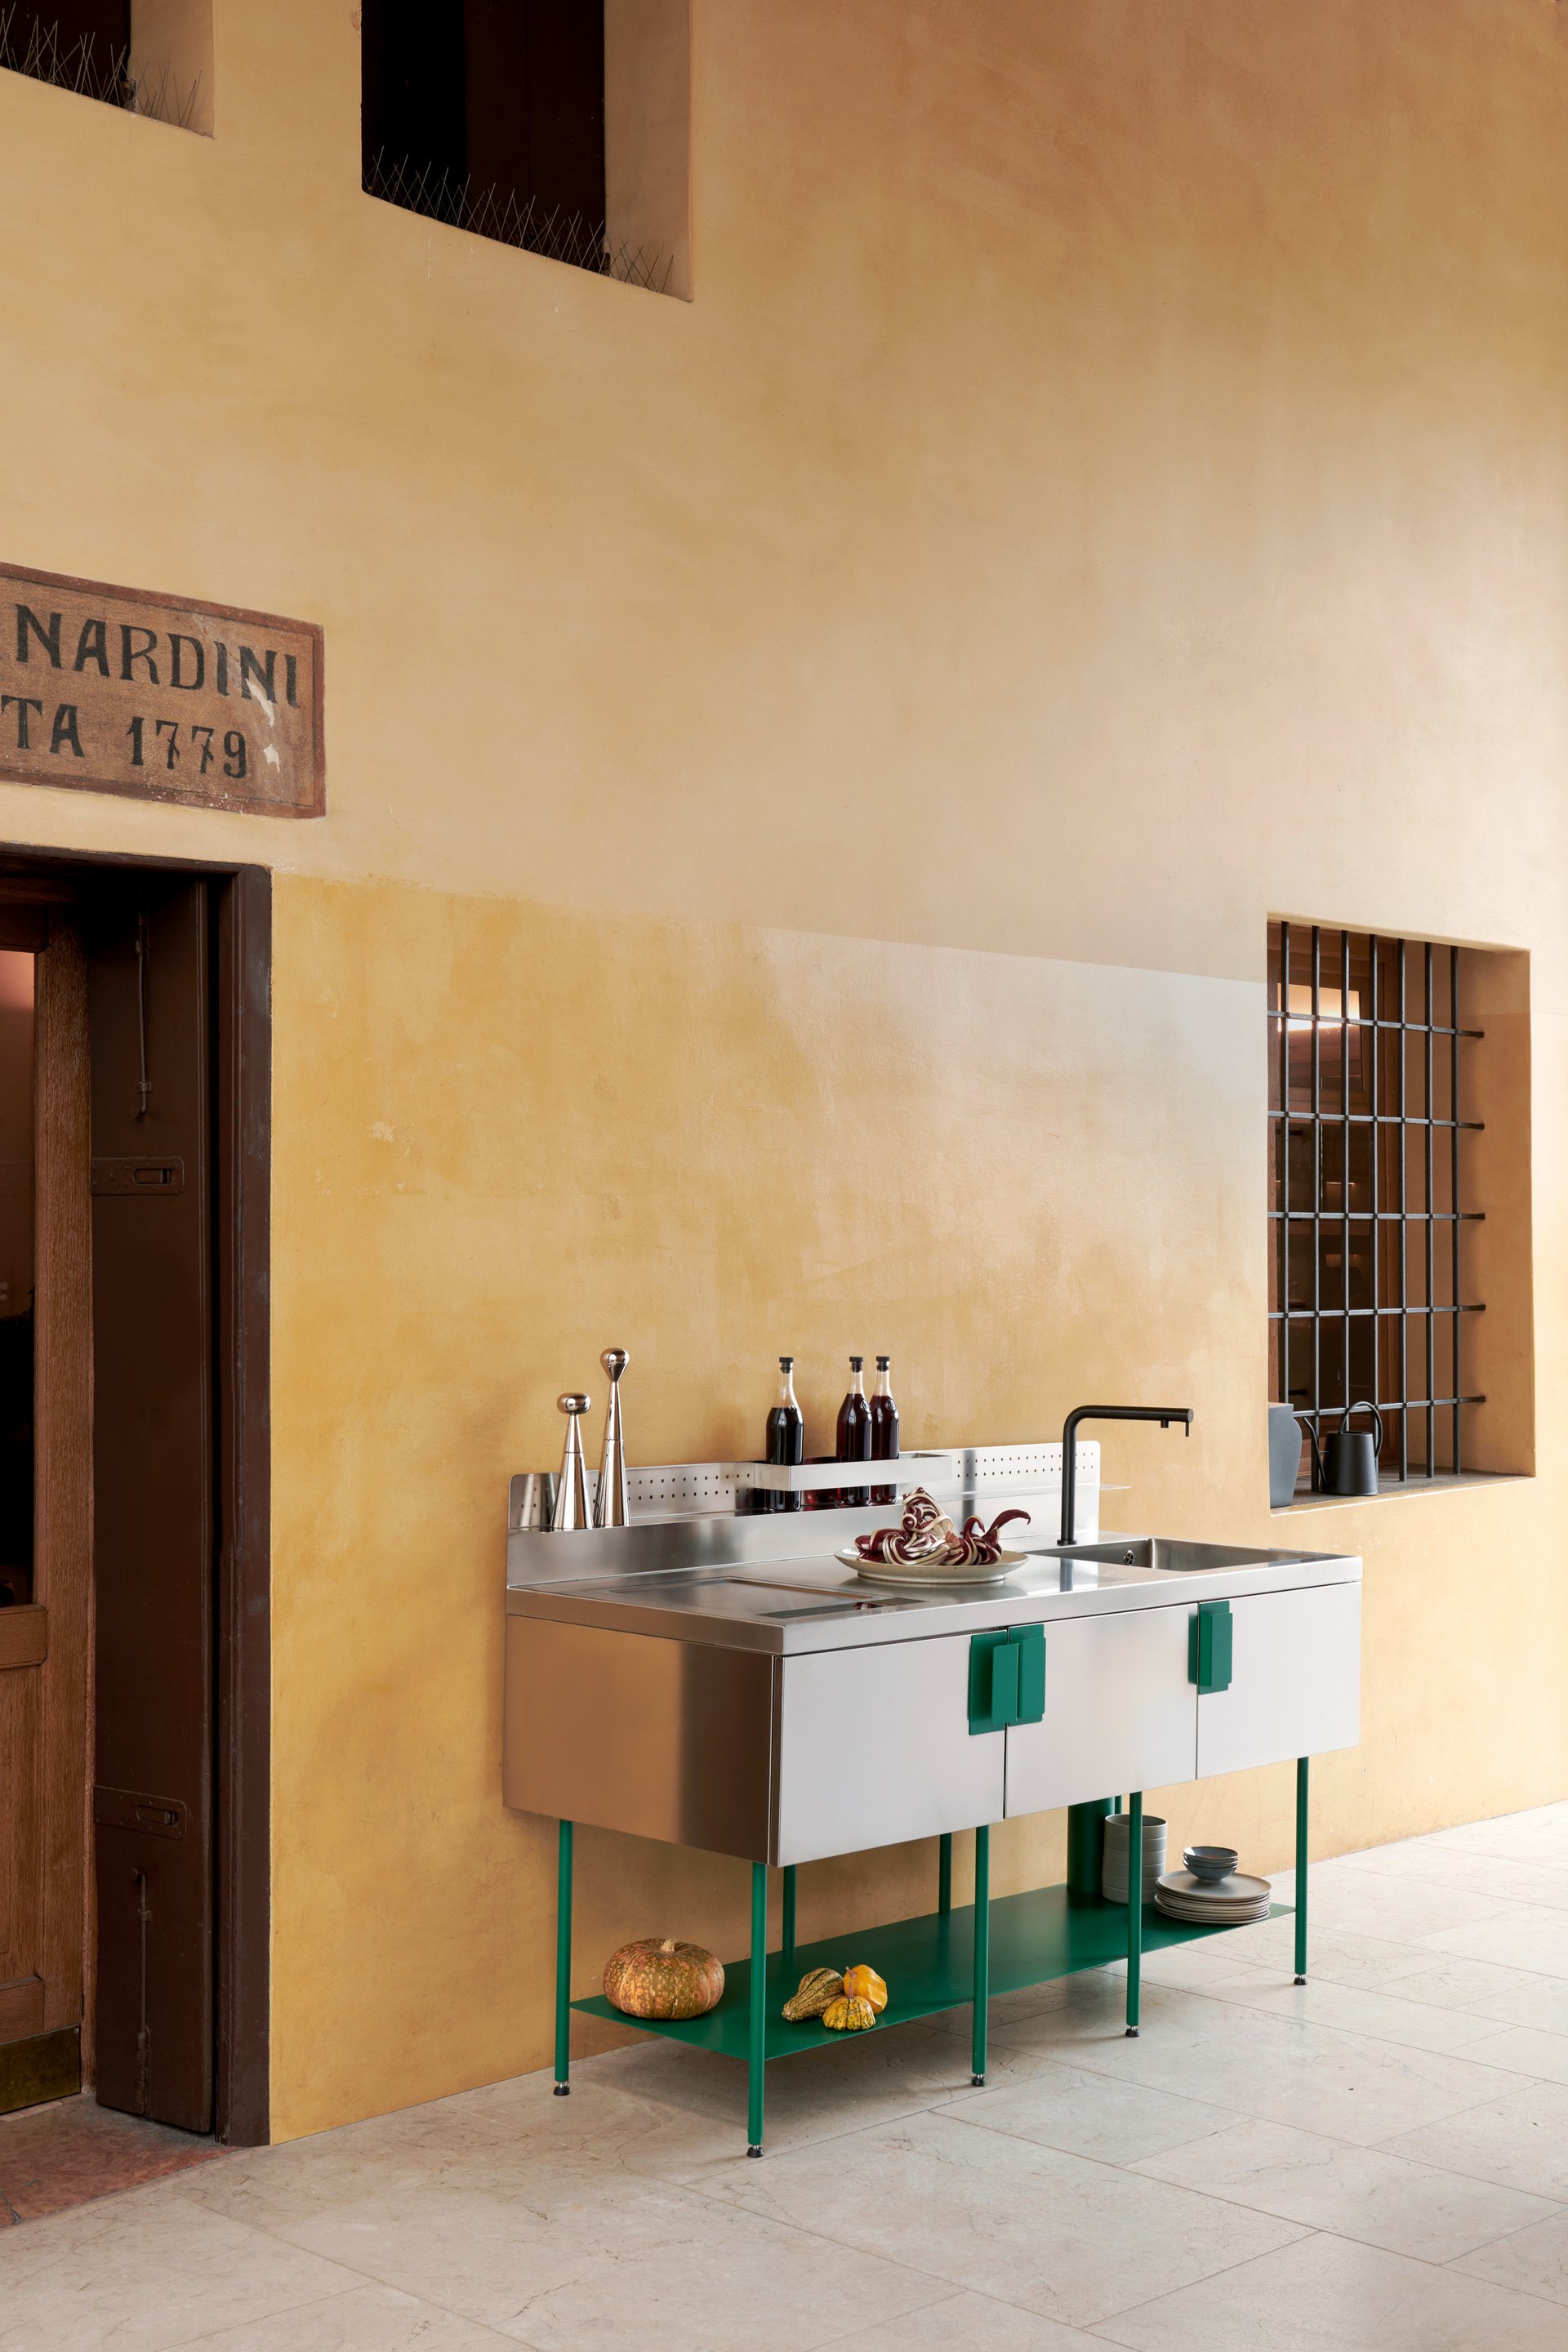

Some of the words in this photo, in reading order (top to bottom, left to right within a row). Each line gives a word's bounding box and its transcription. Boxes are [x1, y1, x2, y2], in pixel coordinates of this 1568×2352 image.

[15, 603, 301, 709] NARDINI
[0, 694, 86, 758] TA
[126, 716, 246, 779] 1779
